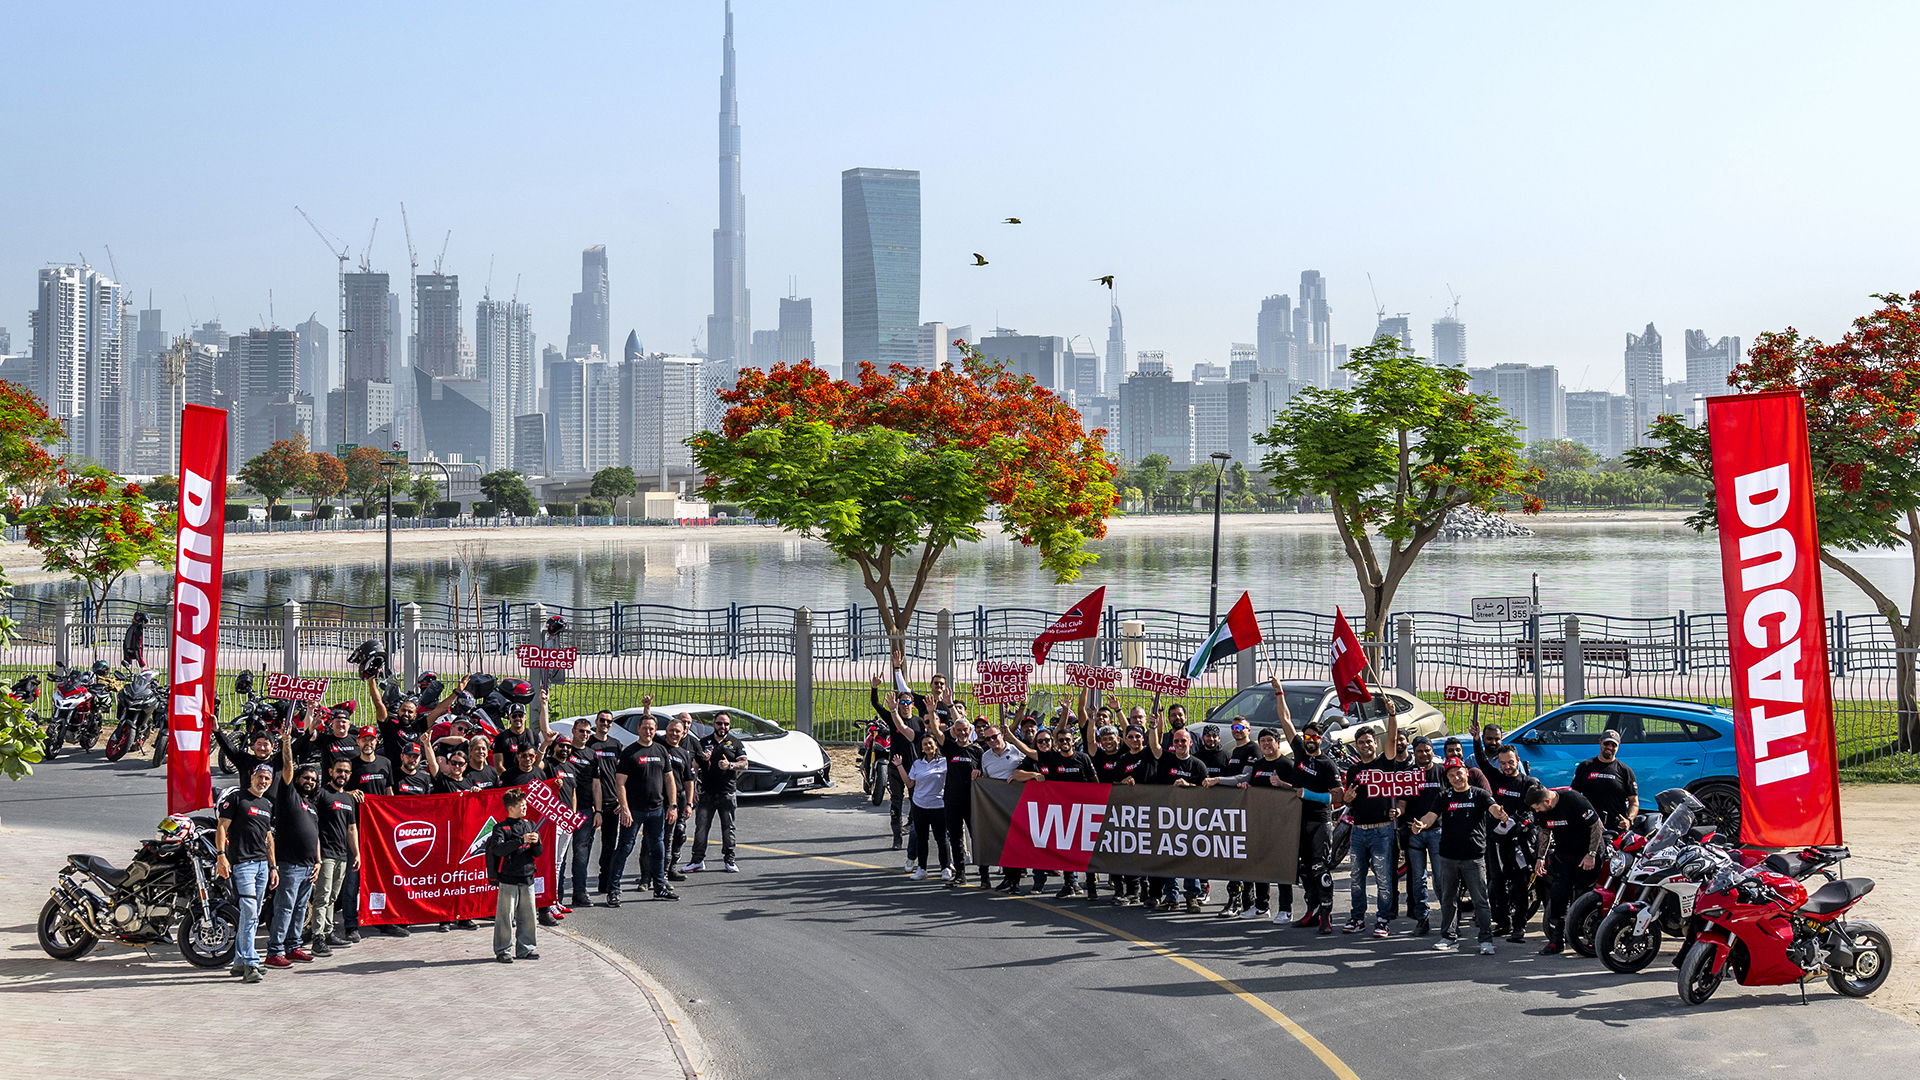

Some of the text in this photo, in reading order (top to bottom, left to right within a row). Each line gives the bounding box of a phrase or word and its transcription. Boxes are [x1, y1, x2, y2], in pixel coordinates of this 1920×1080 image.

[174, 467, 213, 752] DUCATI
[1496, 604, 1505, 616] 2
[1511, 610, 1528, 619] 355
[1068, 620, 1083, 628] Club
[518, 646, 577, 660] #Ducati
[522, 658, 573, 669] Emirates
[977, 661, 1033, 672] #WeAre
[982, 672, 1029, 683] Ducati
[1066, 664, 1122, 680] #WeRide
[1131, 666, 1191, 689] #Ducati
[267, 673, 329, 692] #Ducati
[973, 682, 1029, 696] #Ducati
[1067, 675, 1115, 690] AsOne
[1134, 679, 1186, 697] Emirates
[269, 686, 321, 701] Emirates
[978, 693, 1026, 705] Emirates
[1444, 687, 1511, 706] #Ducati
[1359, 767, 1426, 784] #Ducati
[1367, 783, 1420, 798] Dubai
[527, 780, 587, 828] #Ducati
[525, 791, 574, 834] Emirates
[1108, 805, 1248, 833] ARE DUCATI
[398, 828, 432, 837] DUCATI
[1027, 801, 1108, 851] WE
[1099, 830, 1248, 859] RIDE AS ONE
[393, 868, 489, 887] Ducati Official
[407, 888, 441, 900] United
[443, 885, 467, 897] Arab
